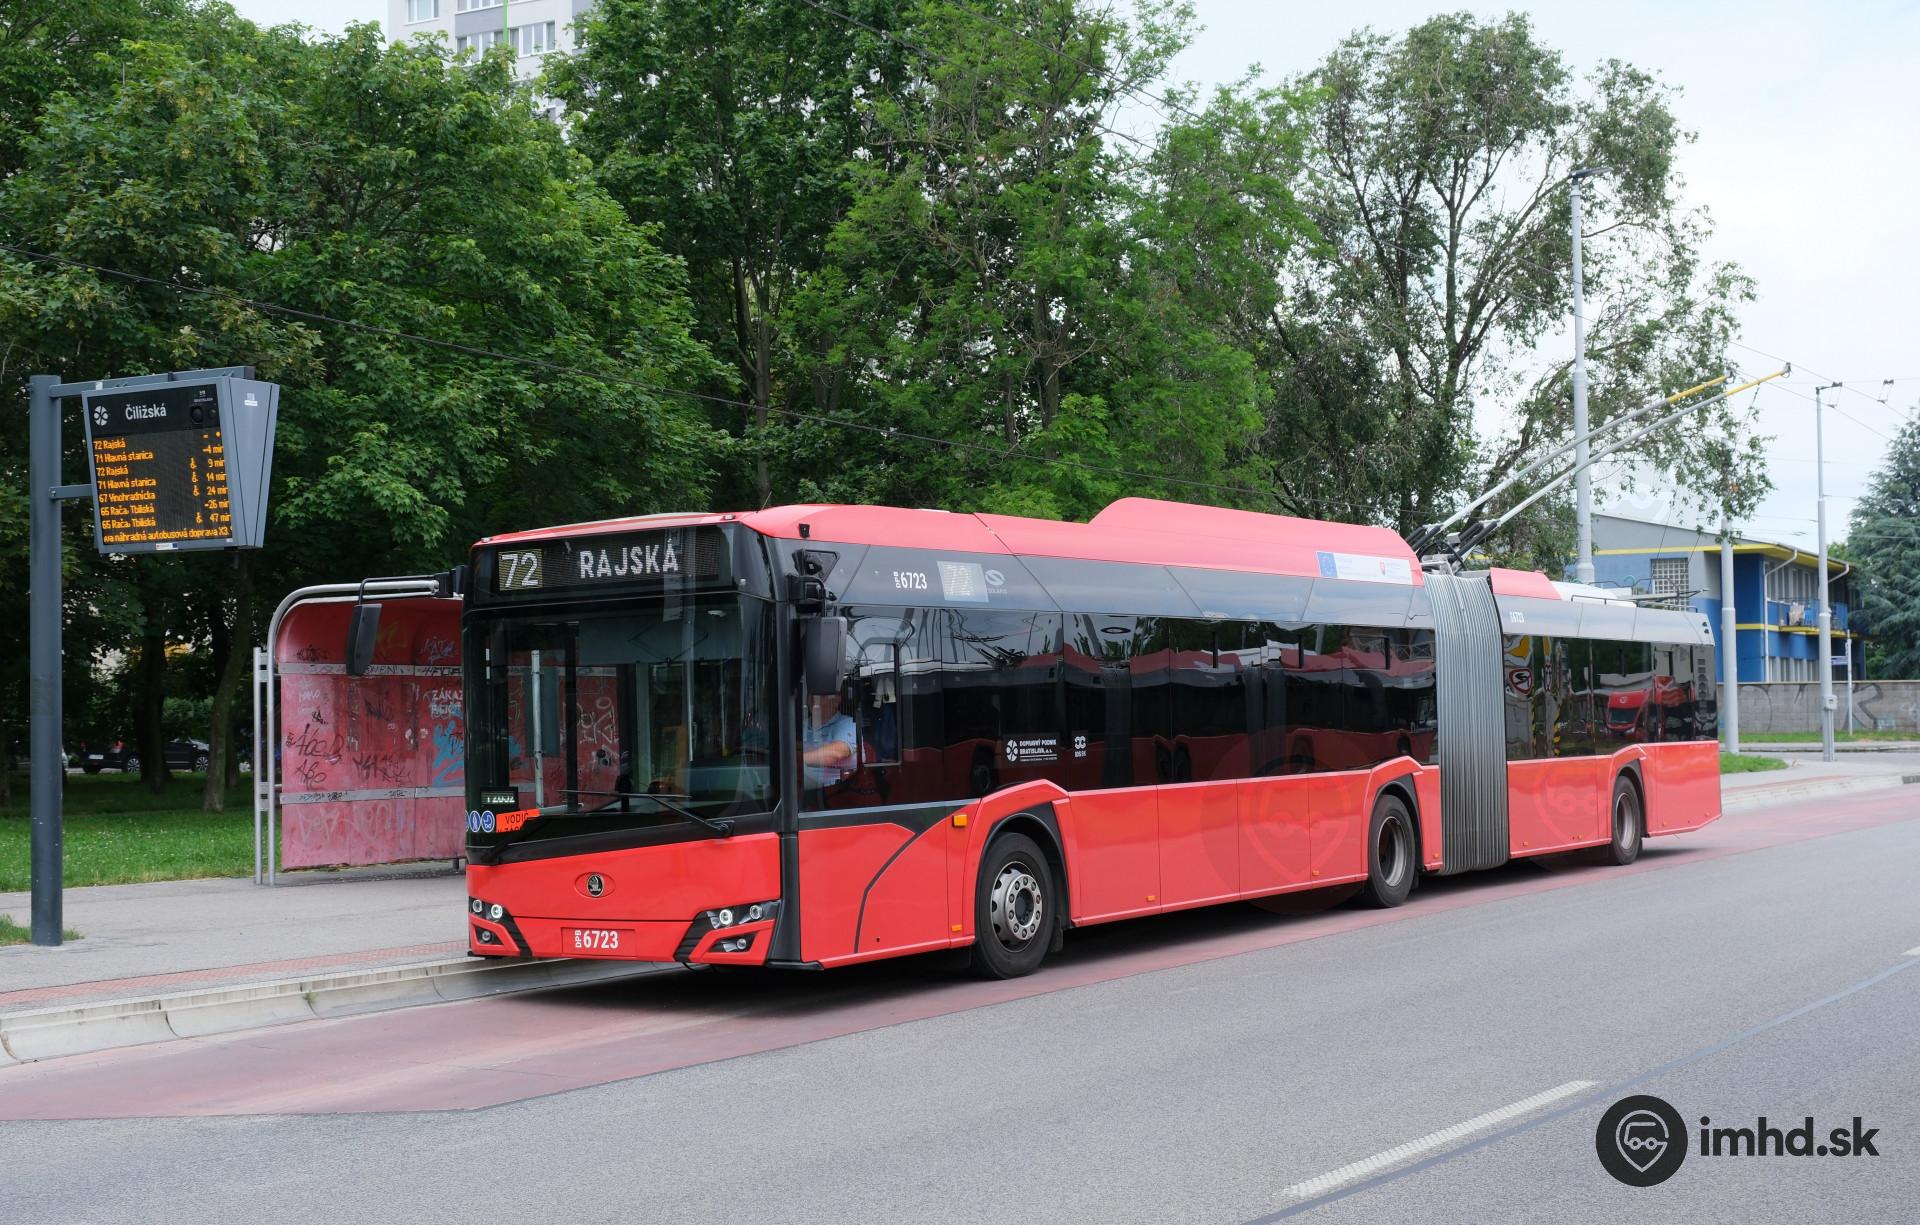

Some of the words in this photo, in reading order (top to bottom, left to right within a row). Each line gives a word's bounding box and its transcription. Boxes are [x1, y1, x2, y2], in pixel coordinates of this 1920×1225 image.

[125, 403, 167, 420] Čiližská
[93, 440, 102, 449] 72
[103, 437, 126, 449] Rajská
[96, 467, 105, 476] 72
[207, 486, 216, 495] 24
[99, 494, 107, 502] 67
[502, 552, 538, 588] 72
[579, 538, 678, 579] RAJSKÁ
[900, 571, 927, 589] 6723
[574, 929, 582, 948] DPB
[583, 930, 619, 949] 6723
